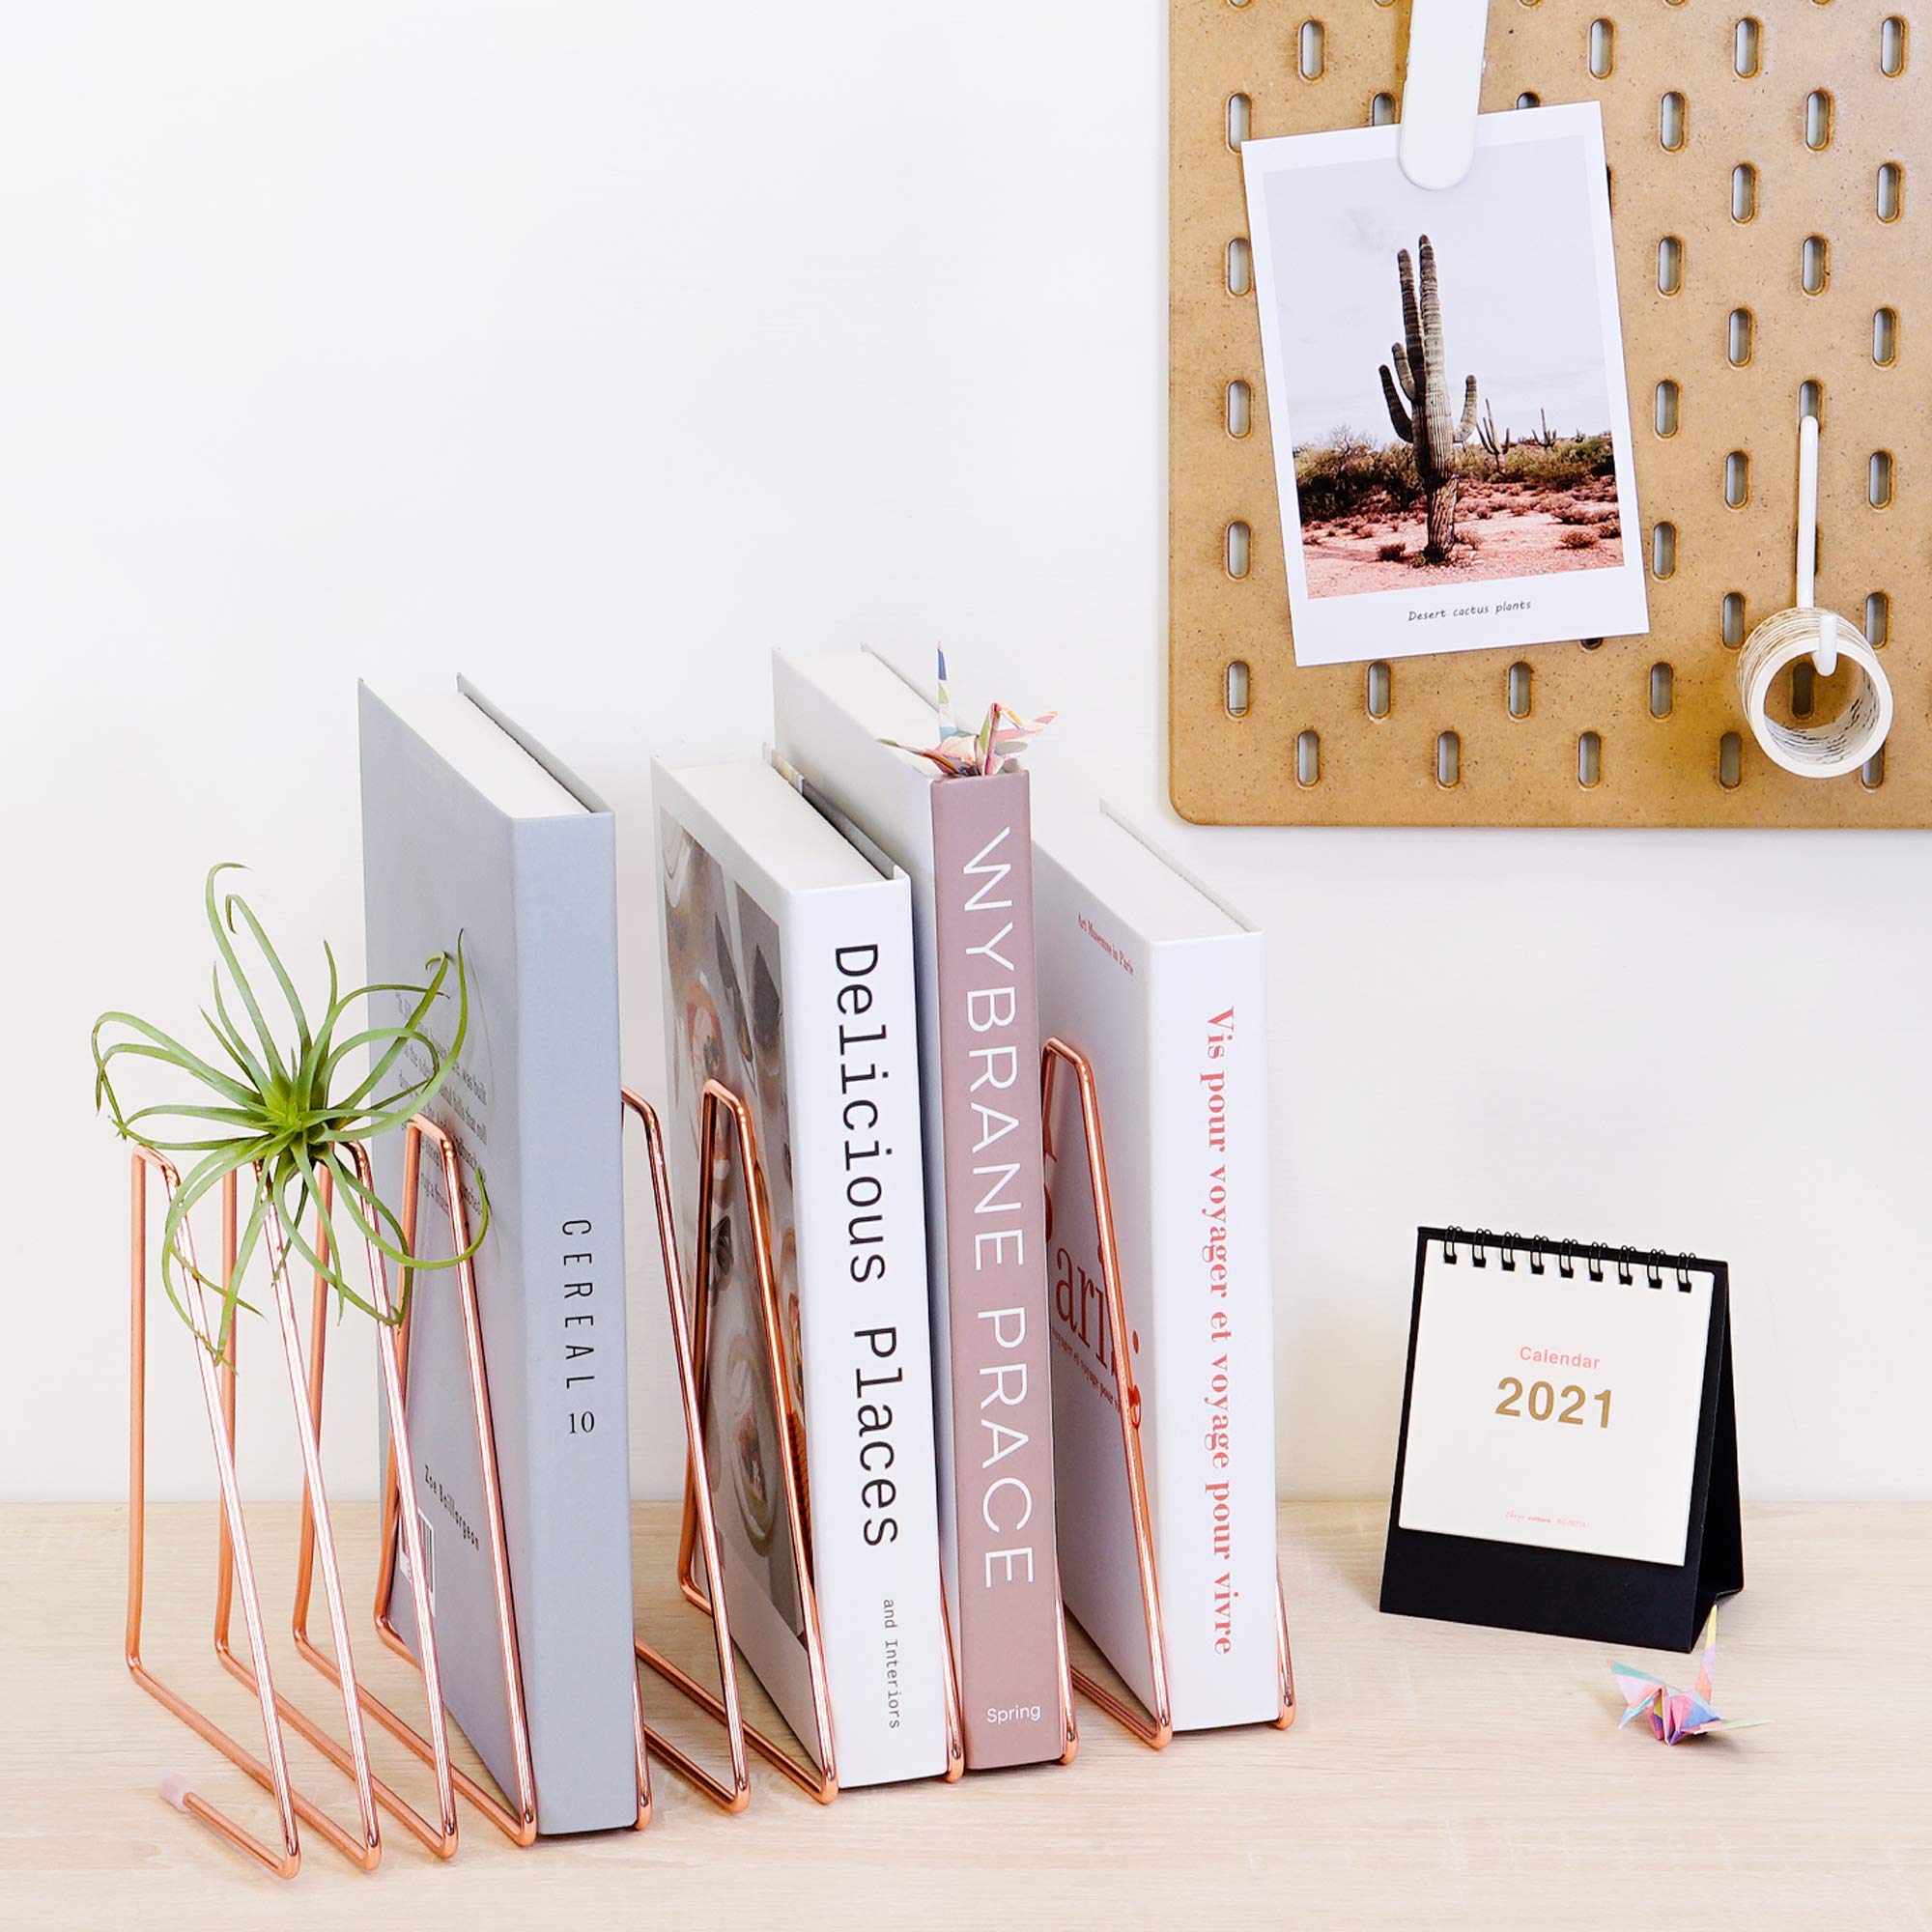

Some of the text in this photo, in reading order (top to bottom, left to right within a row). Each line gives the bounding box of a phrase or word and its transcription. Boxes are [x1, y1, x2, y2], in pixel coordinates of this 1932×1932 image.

[1408, 600, 1531, 621] Desert cactus plants
[836, 944, 902, 1547] Delicious Places
[963, 826, 1035, 1589] WYBRANE PRACE
[562, 1220, 595, 1435] CEREAL 10
[1199, 1007, 1239, 1655] Vis pour voyager et voyage pour vivre
[1519, 1346, 1601, 1370] Calendar
[1494, 1376, 1612, 1430] 2021
[883, 1599, 901, 1729] and Interiors
[985, 1704, 1042, 1725] Spring
